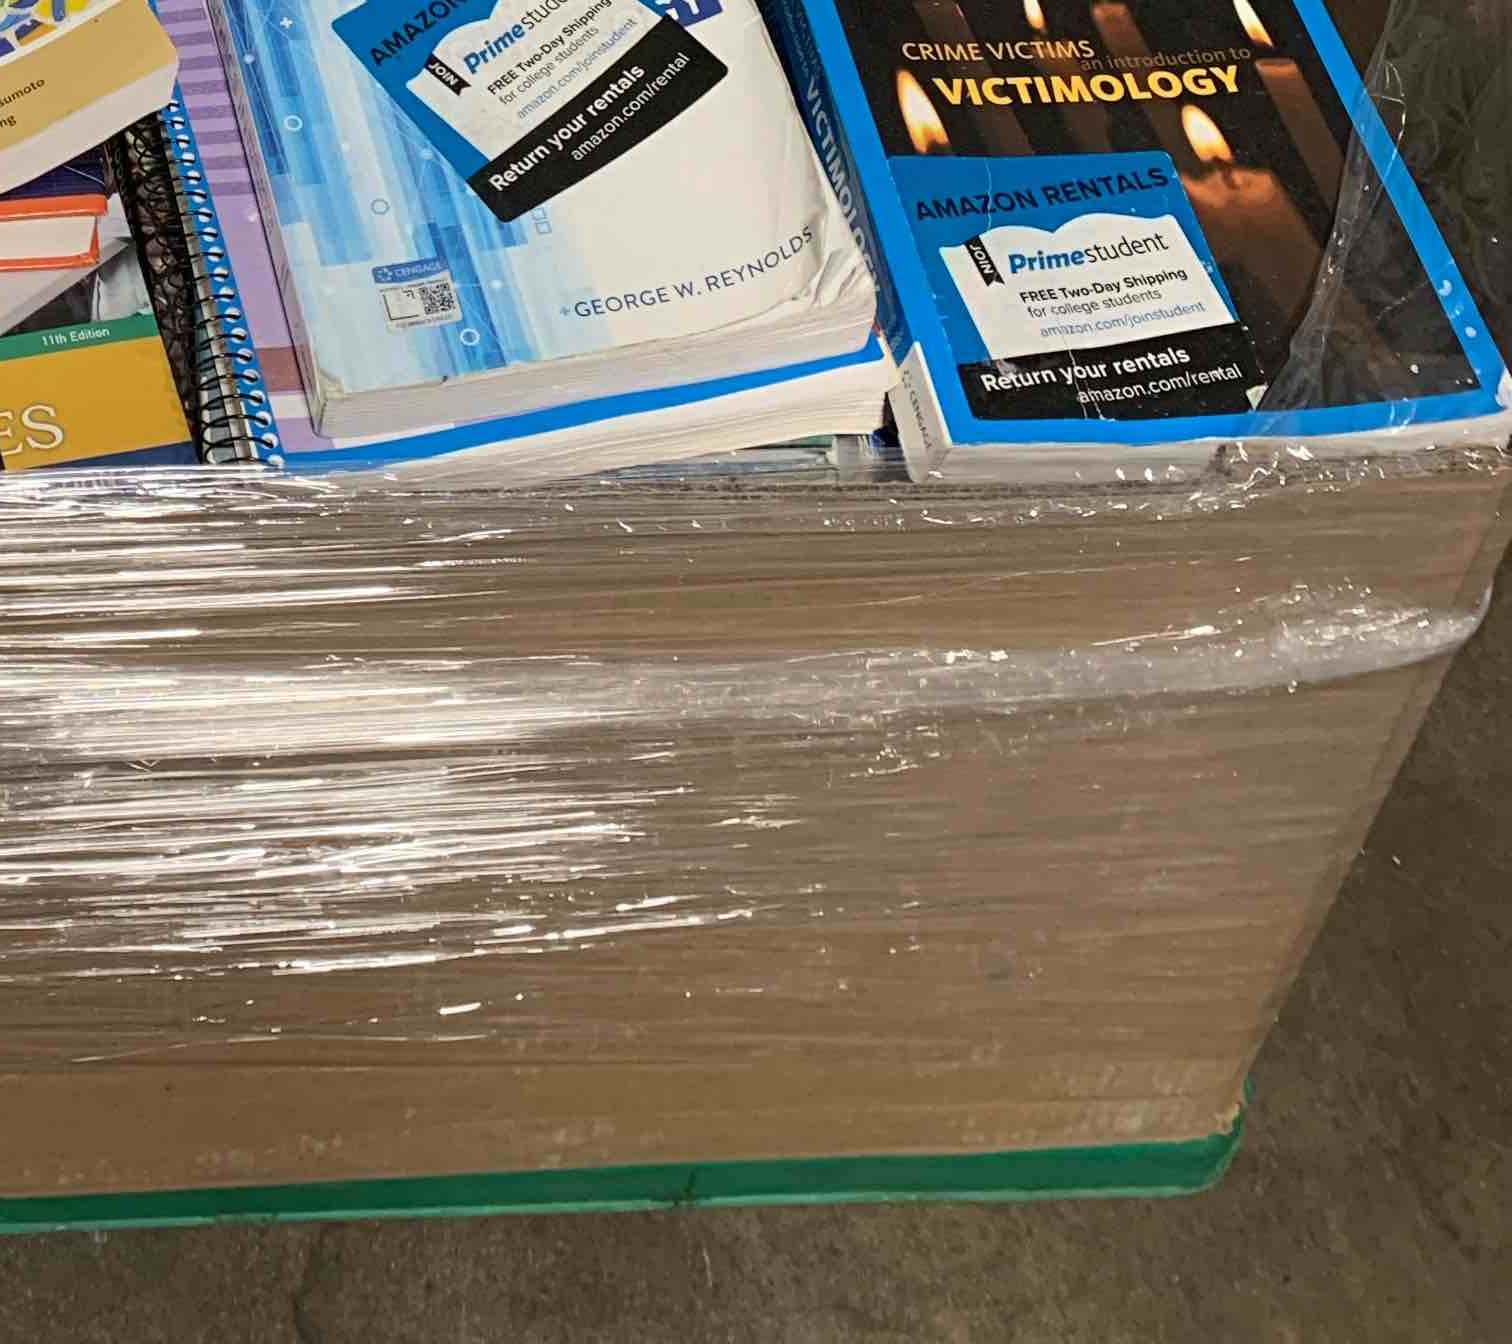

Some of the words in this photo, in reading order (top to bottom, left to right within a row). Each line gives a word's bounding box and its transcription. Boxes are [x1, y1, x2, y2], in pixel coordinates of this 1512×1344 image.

[486, 71, 518, 97] FREE
[517, 38, 566, 73] Two-Day
[901, 41, 984, 62] CRIME
[986, 38, 1096, 62] VICTIMS
[1081, 57, 1104, 73] an
[1104, 47, 1230, 71] introduction
[1230, 46, 1252, 61] to
[569, 51, 692, 162] amazon.com/rental
[932, 64, 1243, 107] VICTIMOLOGY
[488, 142, 551, 193] Return
[548, 112, 588, 151] your
[585, 62, 646, 118] rentals
[915, 190, 1038, 222] AMAZON
[1040, 166, 1170, 207] RENTALS
[573, 284, 672, 319] GEORGE
[672, 277, 702, 300] W.
[703, 225, 816, 292] REYNOLDS
[1019, 287, 1059, 305] FREE
[1061, 279, 1122, 302] Two-Day
[1122, 266, 1189, 293] Shipping
[1050, 299, 1101, 320] college
[1101, 288, 1162, 311] students
[39, 330, 65, 349] 11th
[68, 324, 112, 346] Edition
[980, 369, 1057, 393] Return
[1060, 362, 1109, 386] your
[1112, 345, 1192, 375] rentals
[1075, 362, 1244, 406] amazon.com/rental
